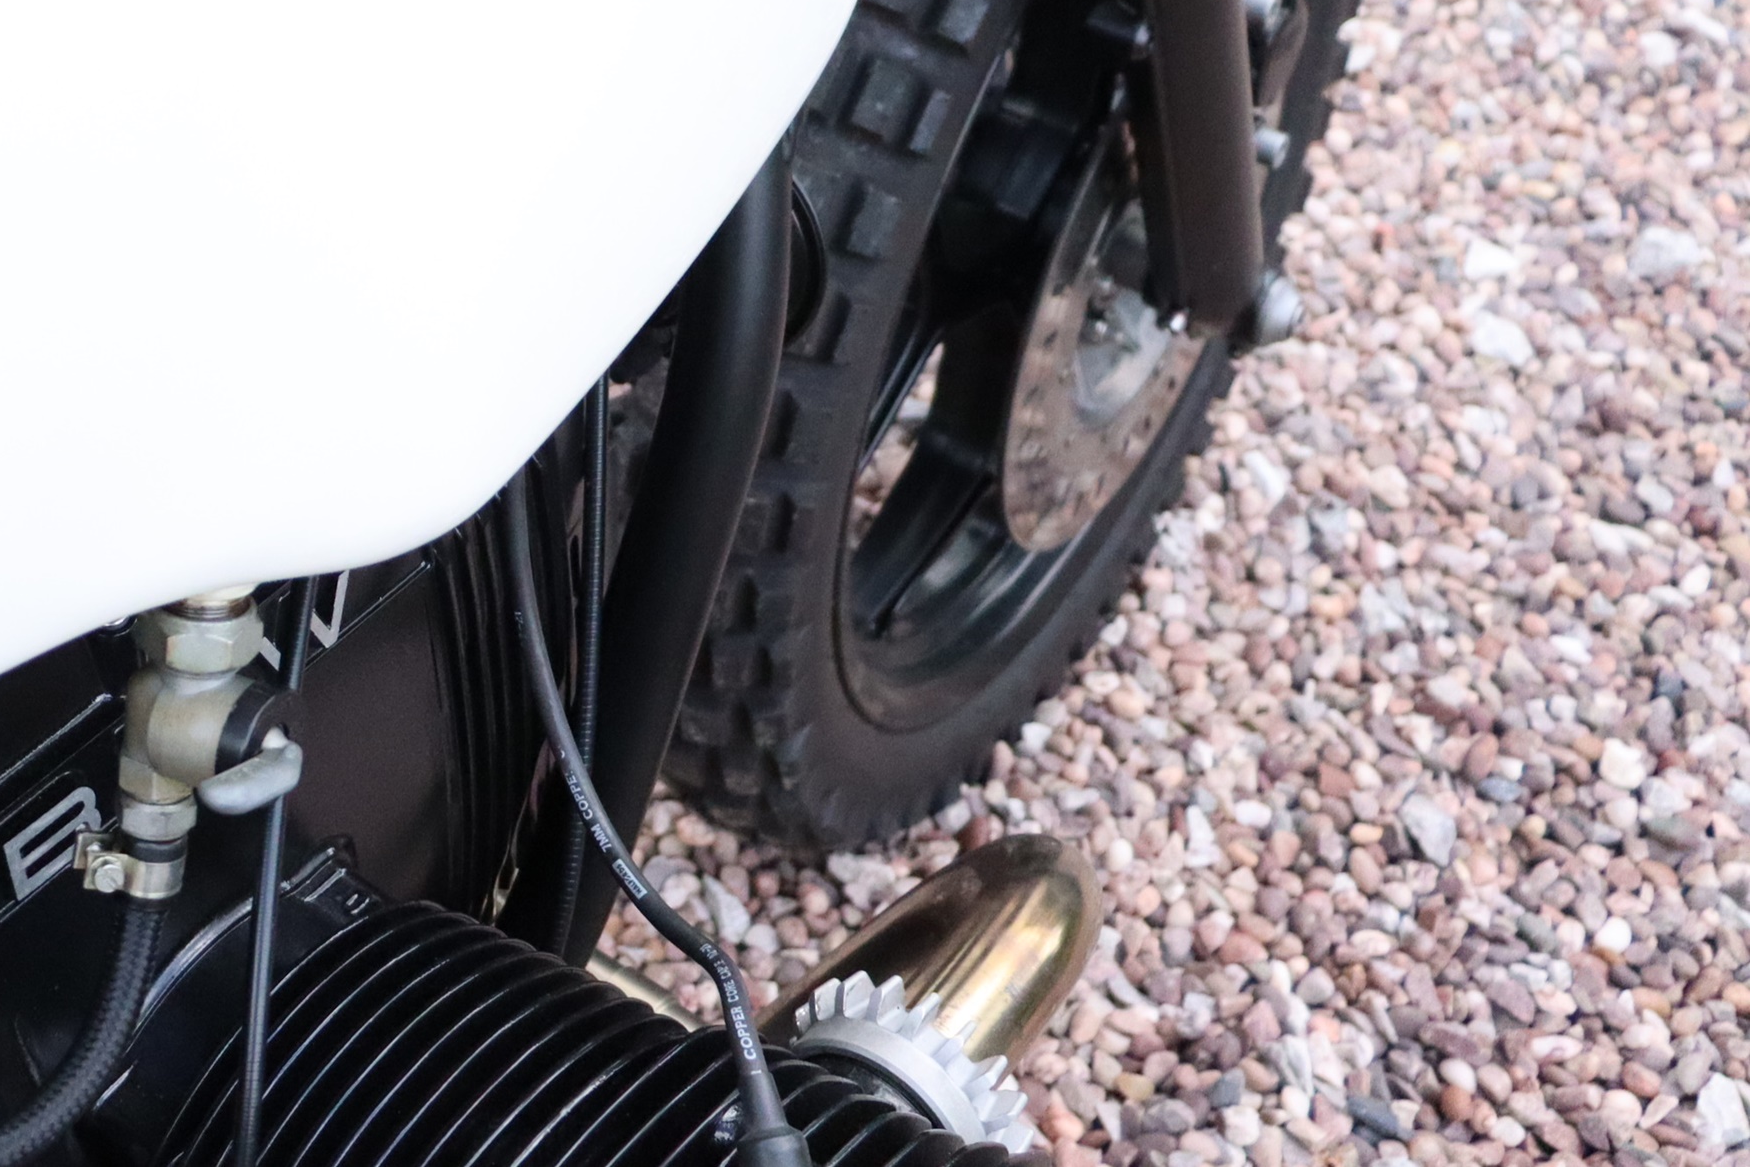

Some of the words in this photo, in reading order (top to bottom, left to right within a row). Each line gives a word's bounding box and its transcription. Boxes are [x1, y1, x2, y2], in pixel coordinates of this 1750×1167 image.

[590, 823, 612, 853] 7MM
[723, 979, 739, 1003] CORE
[731, 1006, 757, 1060] COPPER
